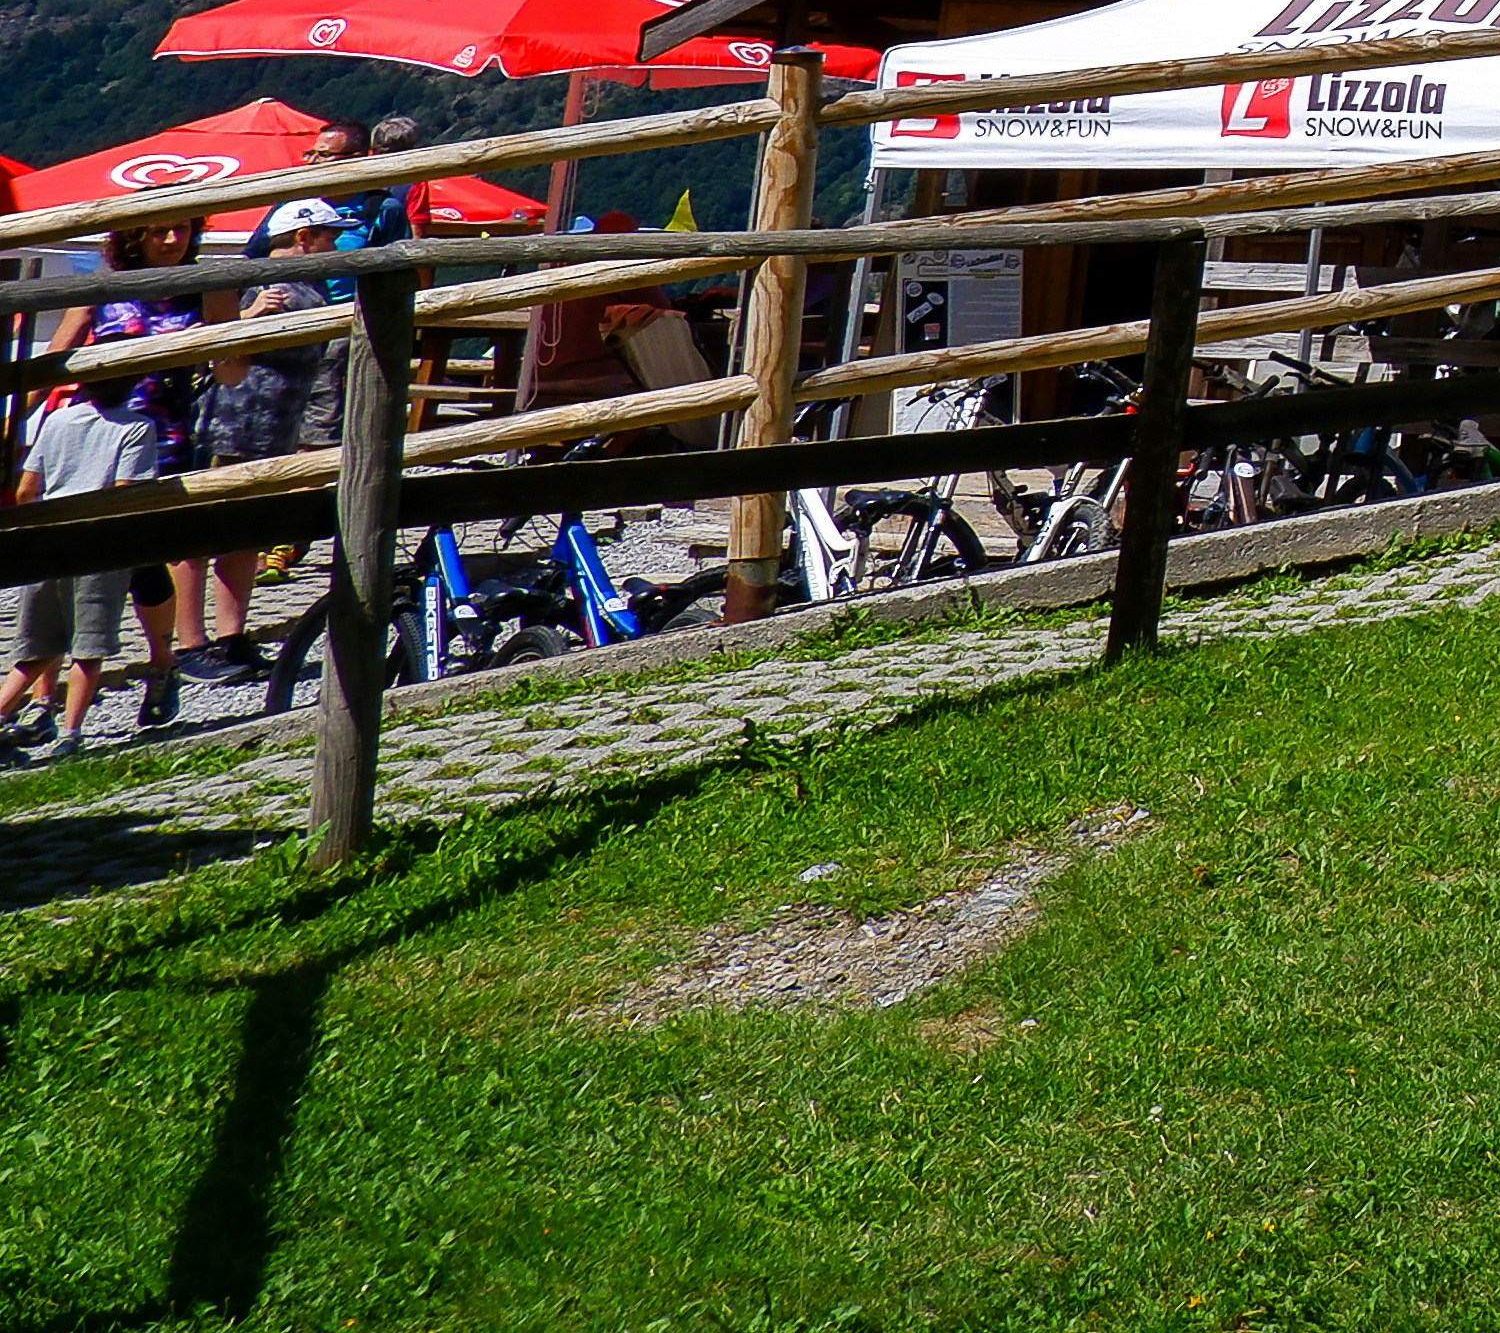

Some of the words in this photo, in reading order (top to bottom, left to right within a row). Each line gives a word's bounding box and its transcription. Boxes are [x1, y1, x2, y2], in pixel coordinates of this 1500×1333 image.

[1306, 73, 1448, 115] Lizzola
[974, 118, 1112, 138] SNOW&FUN
[1304, 117, 1443, 139] SNOW&FUN
